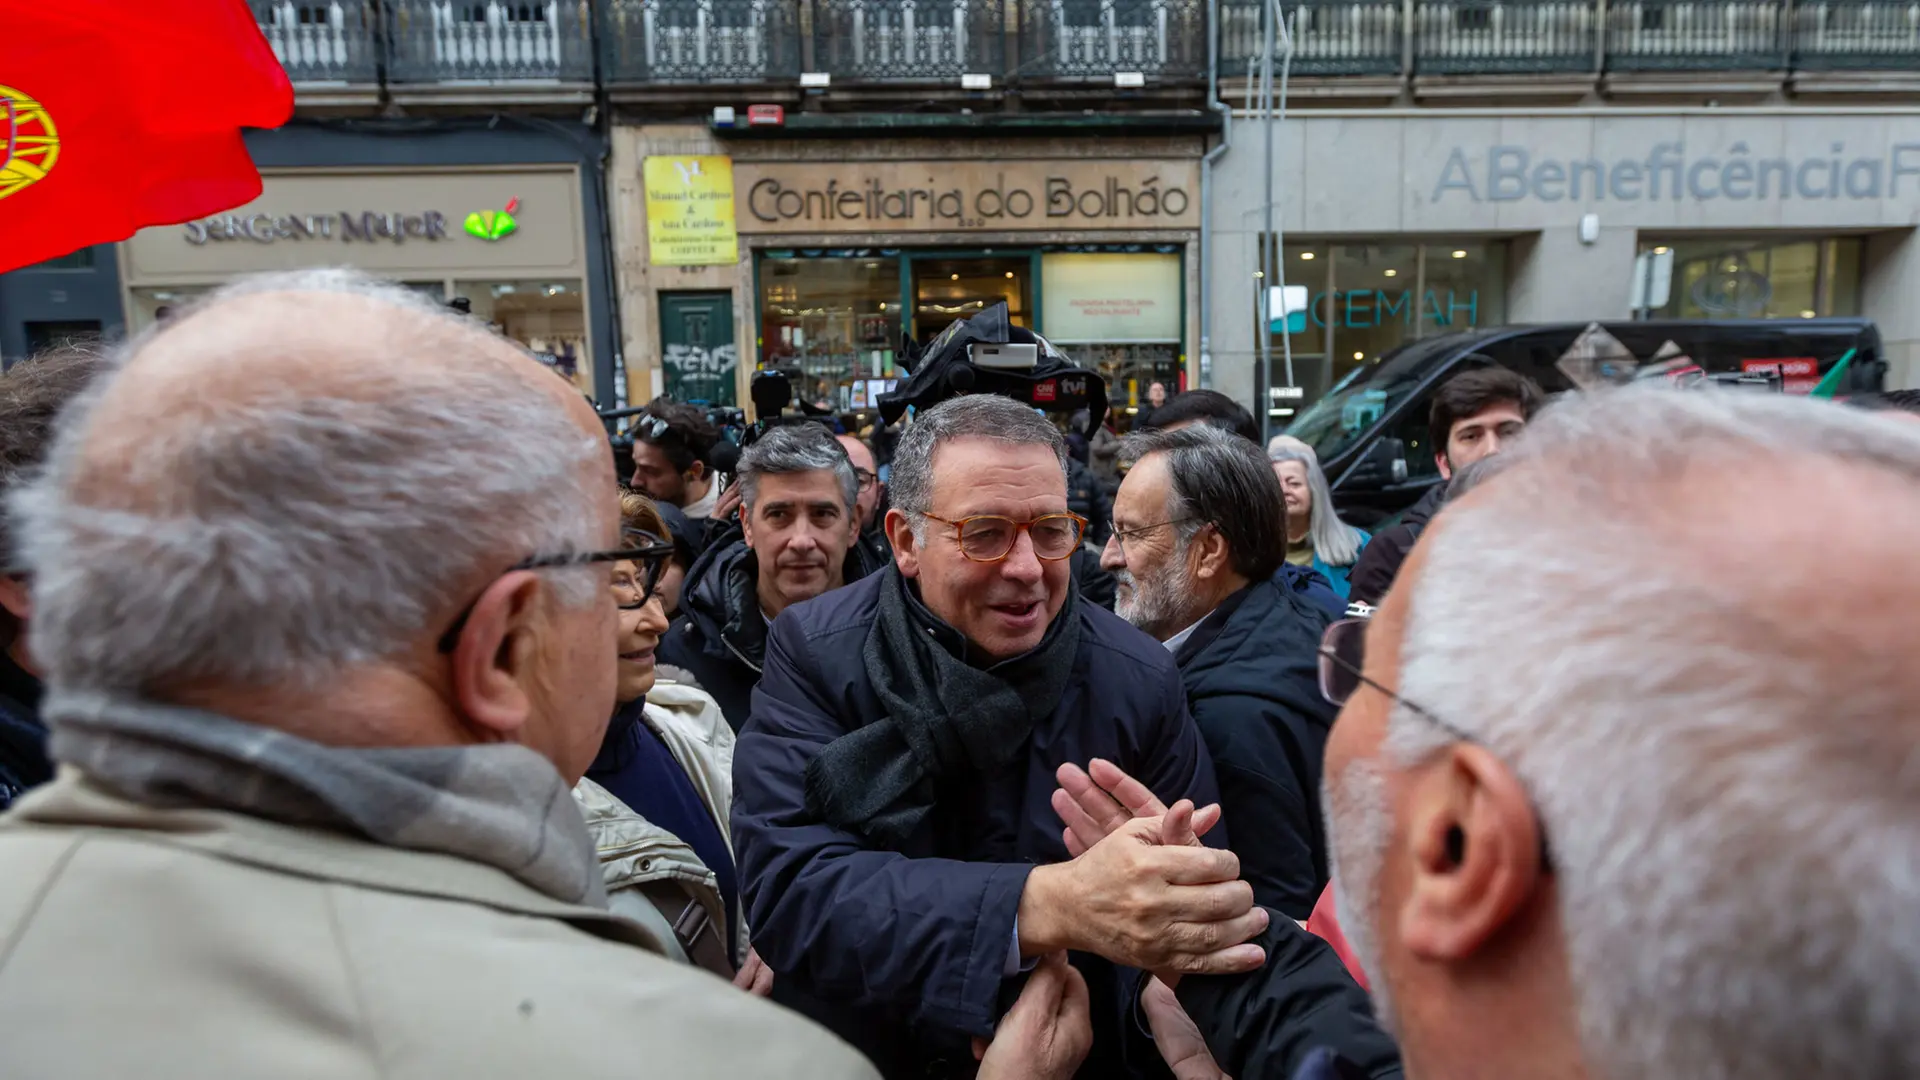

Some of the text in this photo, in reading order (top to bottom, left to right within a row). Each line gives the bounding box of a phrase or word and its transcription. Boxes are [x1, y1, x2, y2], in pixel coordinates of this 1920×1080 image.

[748, 178, 963, 222] Confeitaria
[975, 172, 1034, 218] do
[1310, 288, 1478, 328] CEMAH
[1061, 376, 1087, 395] tvi
